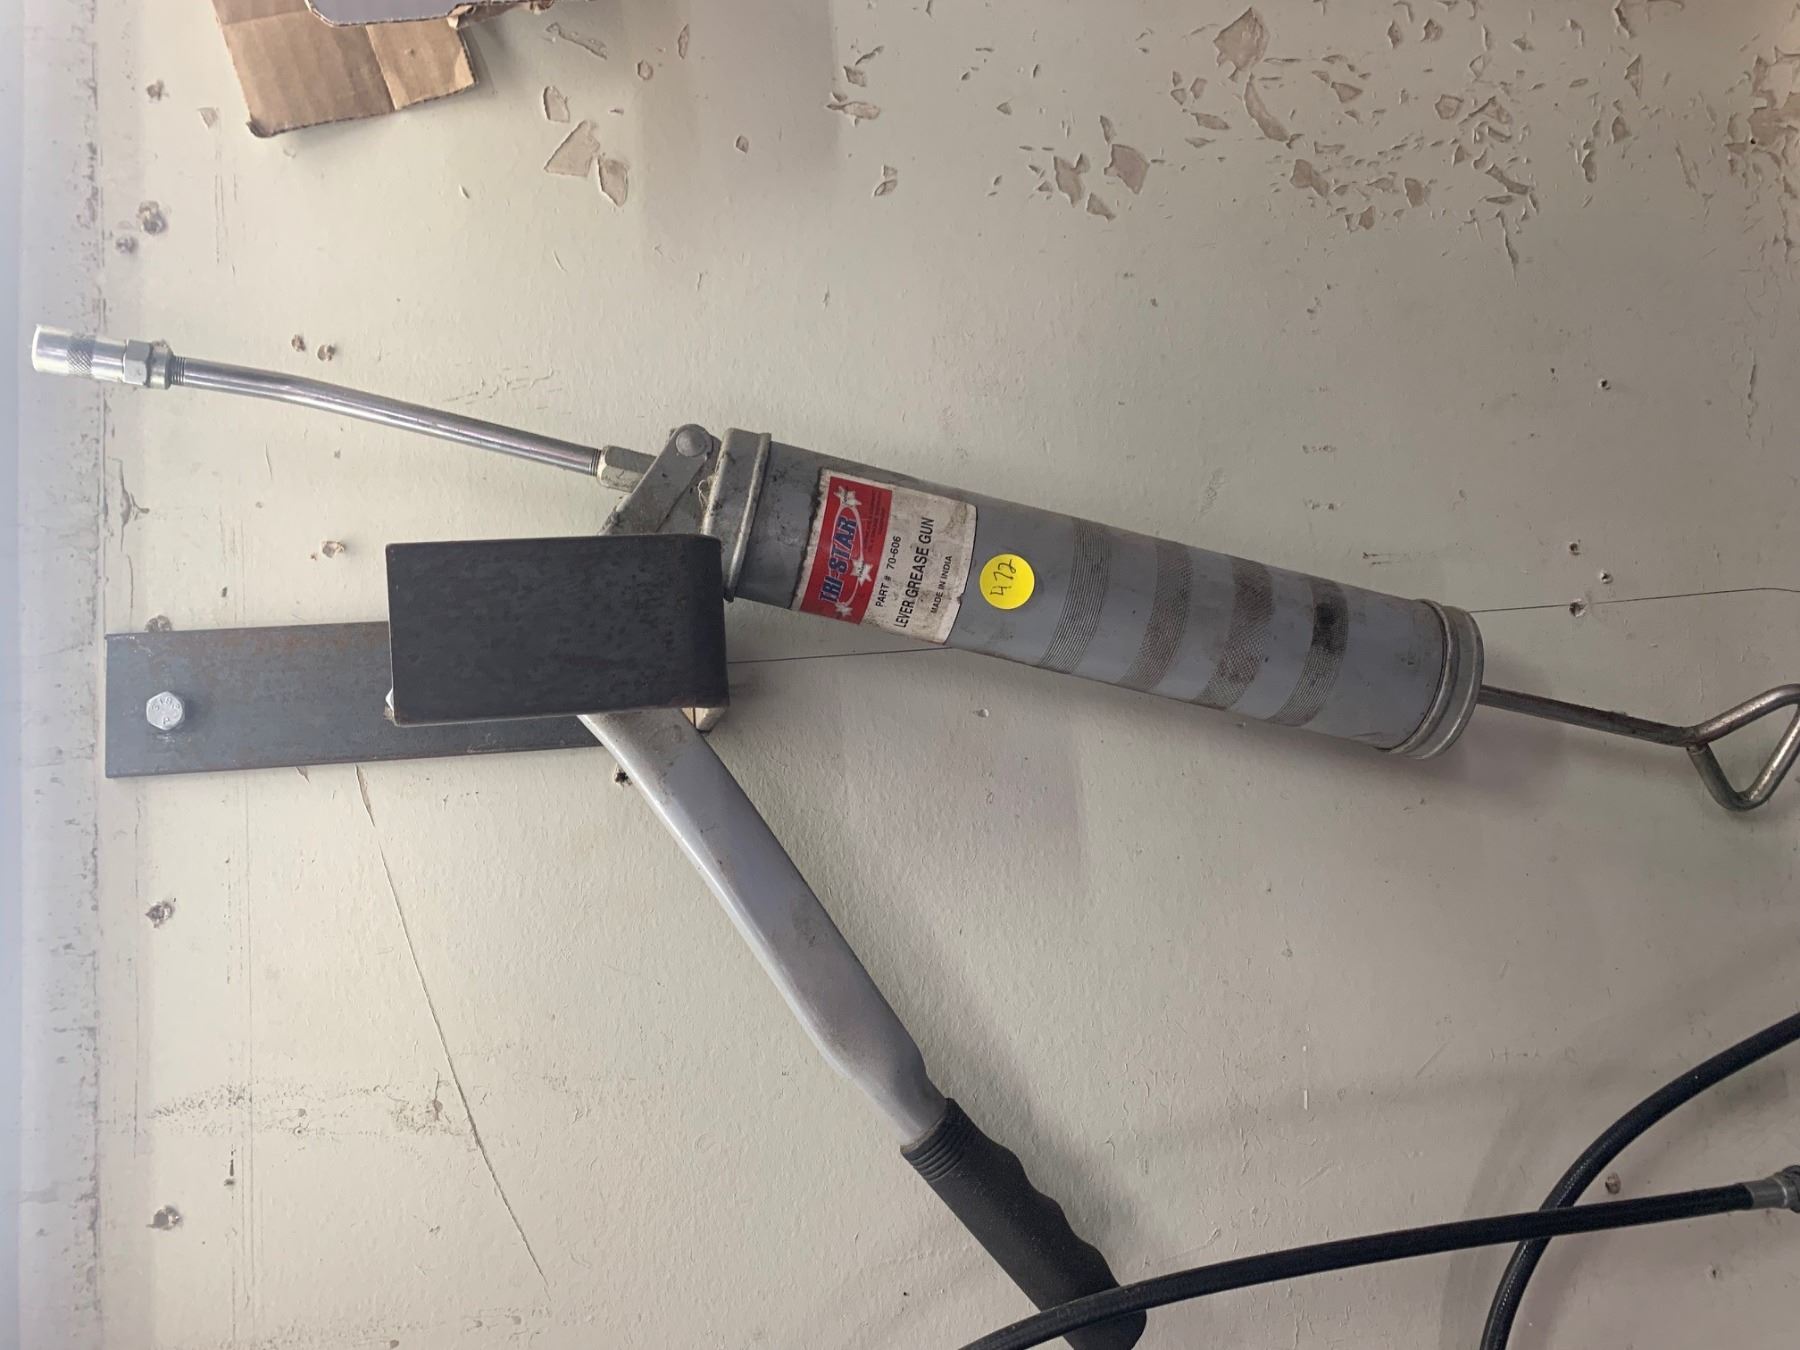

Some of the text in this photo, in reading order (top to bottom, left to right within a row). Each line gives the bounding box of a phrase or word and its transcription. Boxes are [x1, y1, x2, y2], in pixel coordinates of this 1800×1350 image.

[818, 515, 858, 603] TRI-STAR
[876, 582, 890, 607] PART
[886, 536, 902, 570] 70-606
[894, 517, 935, 628] LEVER GREASE GUN
[930, 555, 953, 614] MADE IN INDIA
[989, 558, 1017, 596] 472
